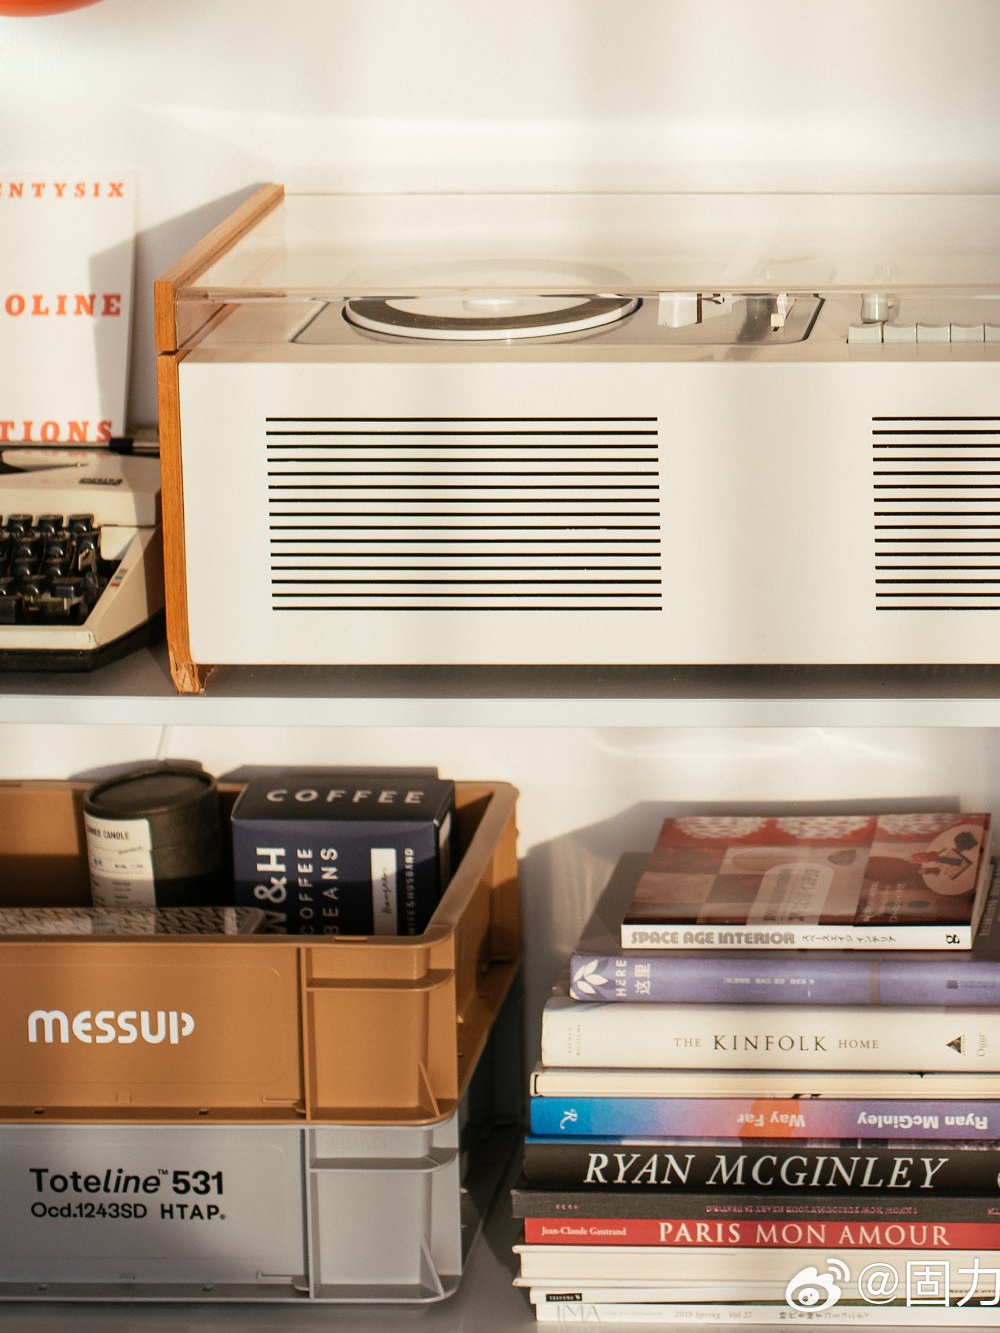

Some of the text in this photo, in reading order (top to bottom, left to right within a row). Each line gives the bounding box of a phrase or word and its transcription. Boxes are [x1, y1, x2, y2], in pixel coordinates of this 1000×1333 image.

[0, 181, 124, 198] NTYSIX
[5, 293, 122, 317] OLINE
[266, 789, 424, 804] COFFEE
[297, 848, 315, 934] COFFEE
[320, 848, 339, 934] BEANS
[631, 932, 795, 944] SPACE AGE INTERIOR
[616, 960, 627, 997] HERE
[635, 963, 651, 996] 这里
[673, 1035, 879, 1051] THE KINFOLK HOME
[737, 1111, 805, 1128] Way Far
[857, 1111, 988, 1130] Ryan McGinley
[583, 1153, 948, 1188] RYAN MCGINLEY
[172, 1170, 224, 1195] 531
[31, 1202, 147, 1219] Ocd.1243SD
[541, 1226, 627, 1238] Jean-Claude Gautrand
[660, 1222, 951, 1246] PARIS MON AMOUR
[557, 1305, 601, 1322] IMA
